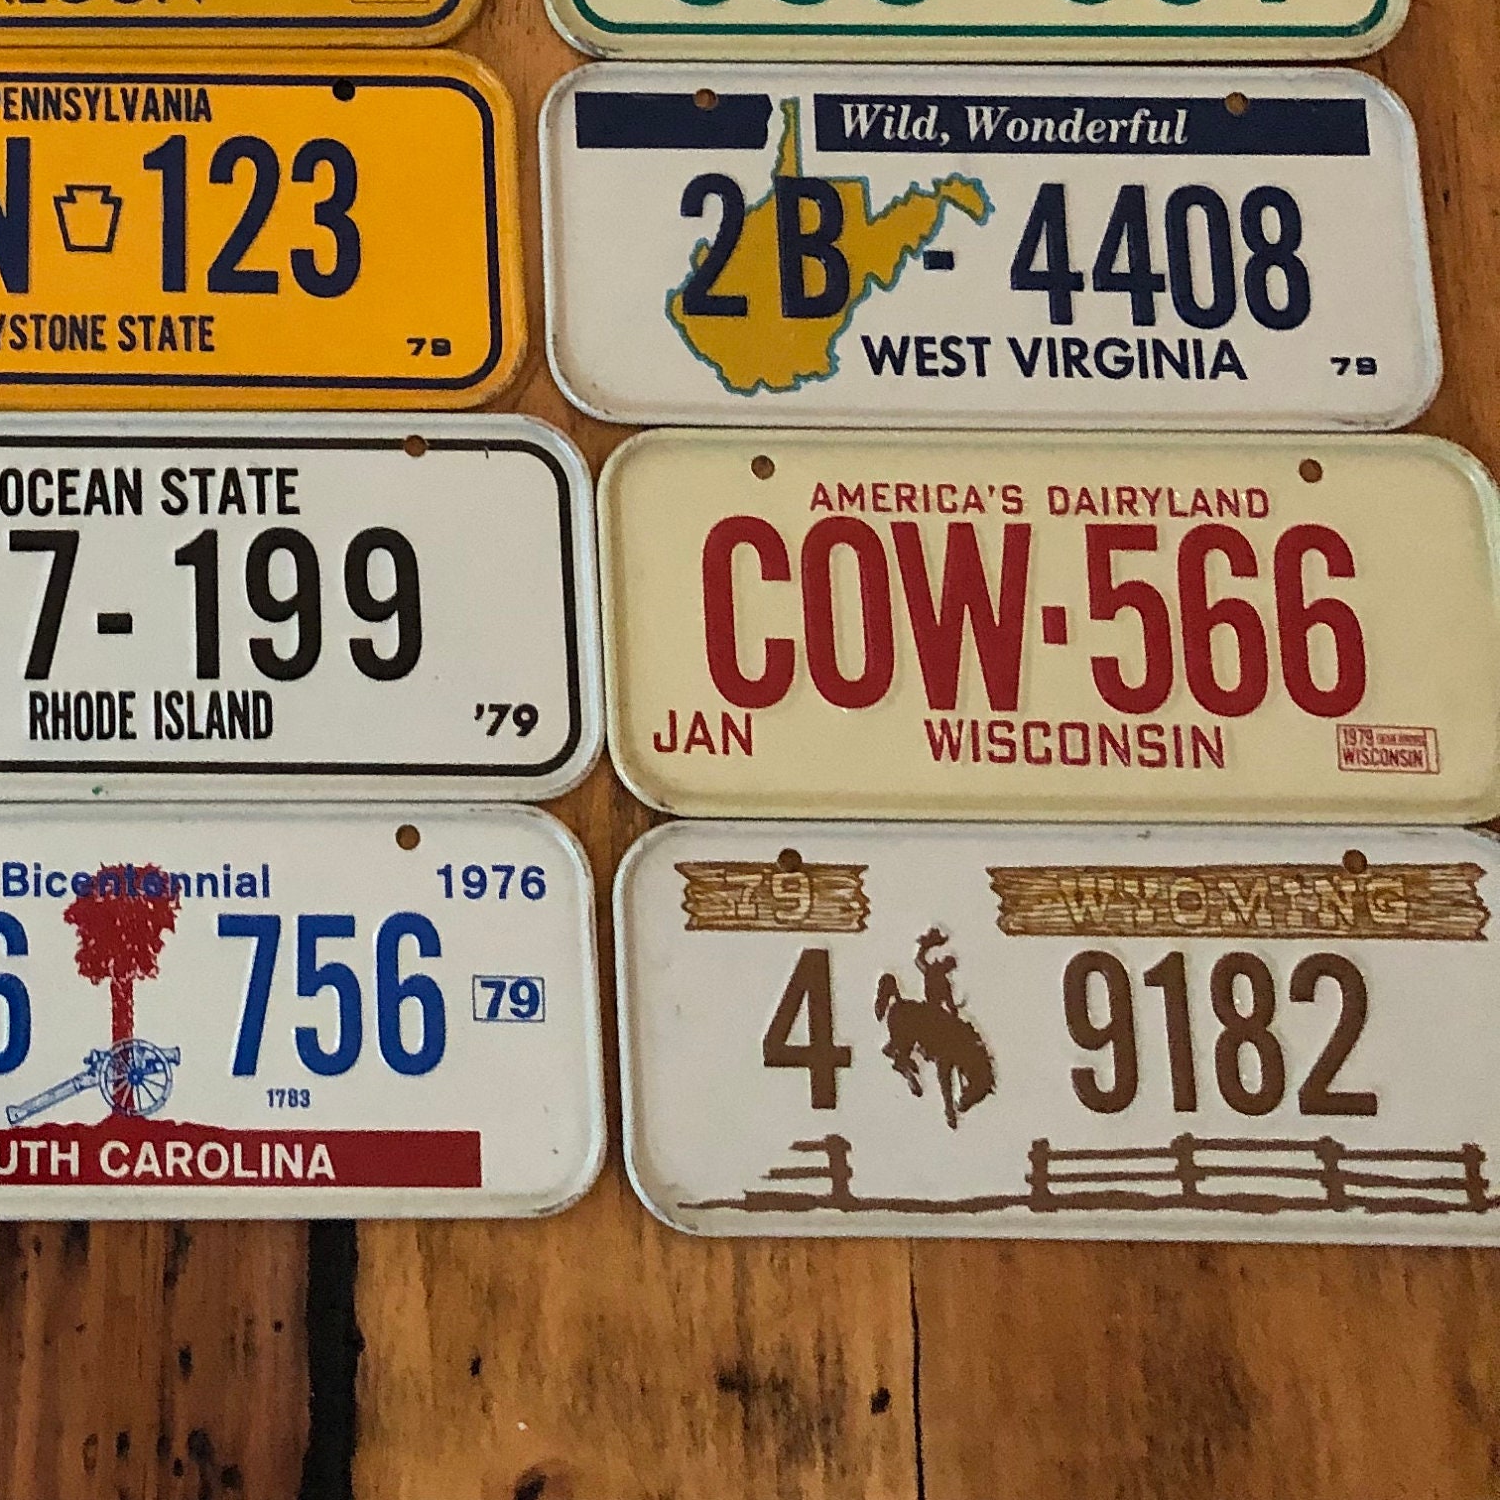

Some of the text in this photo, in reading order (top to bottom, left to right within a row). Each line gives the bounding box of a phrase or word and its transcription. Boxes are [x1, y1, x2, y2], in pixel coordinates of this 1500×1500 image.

[840, 104, 1188, 146] Wild, Wonderful
[142, 134, 362, 298] 123
[1009, 183, 1312, 332] 4408
[118, 315, 214, 352] STATE
[406, 338, 452, 358] 79
[861, 335, 1248, 381] WEST VIRGINIA
[1331, 358, 1378, 376] 79
[0, 468, 300, 516] OCEAN STATE
[811, 482, 1270, 519] AMERICA'S DAIRYLAND
[30, 691, 274, 741] RHODE ISLAND
[653, 710, 753, 755] JAN
[924, 719, 1225, 769] WISCONSIN
[1343, 748, 1423, 767] WISCONSIN
[1, 862, 270, 898] Bicentennial
[437, 864, 546, 900] 1976
[723, 873, 814, 922] 79
[1056, 876, 1411, 927] WYOMING
[217, 912, 446, 1078] 756
[481, 980, 540, 1017] 79
[762, 948, 1378, 1117] 4 9182
[267, 1089, 310, 1108] 1783
[100, 1142, 335, 1181] CAROLINA
